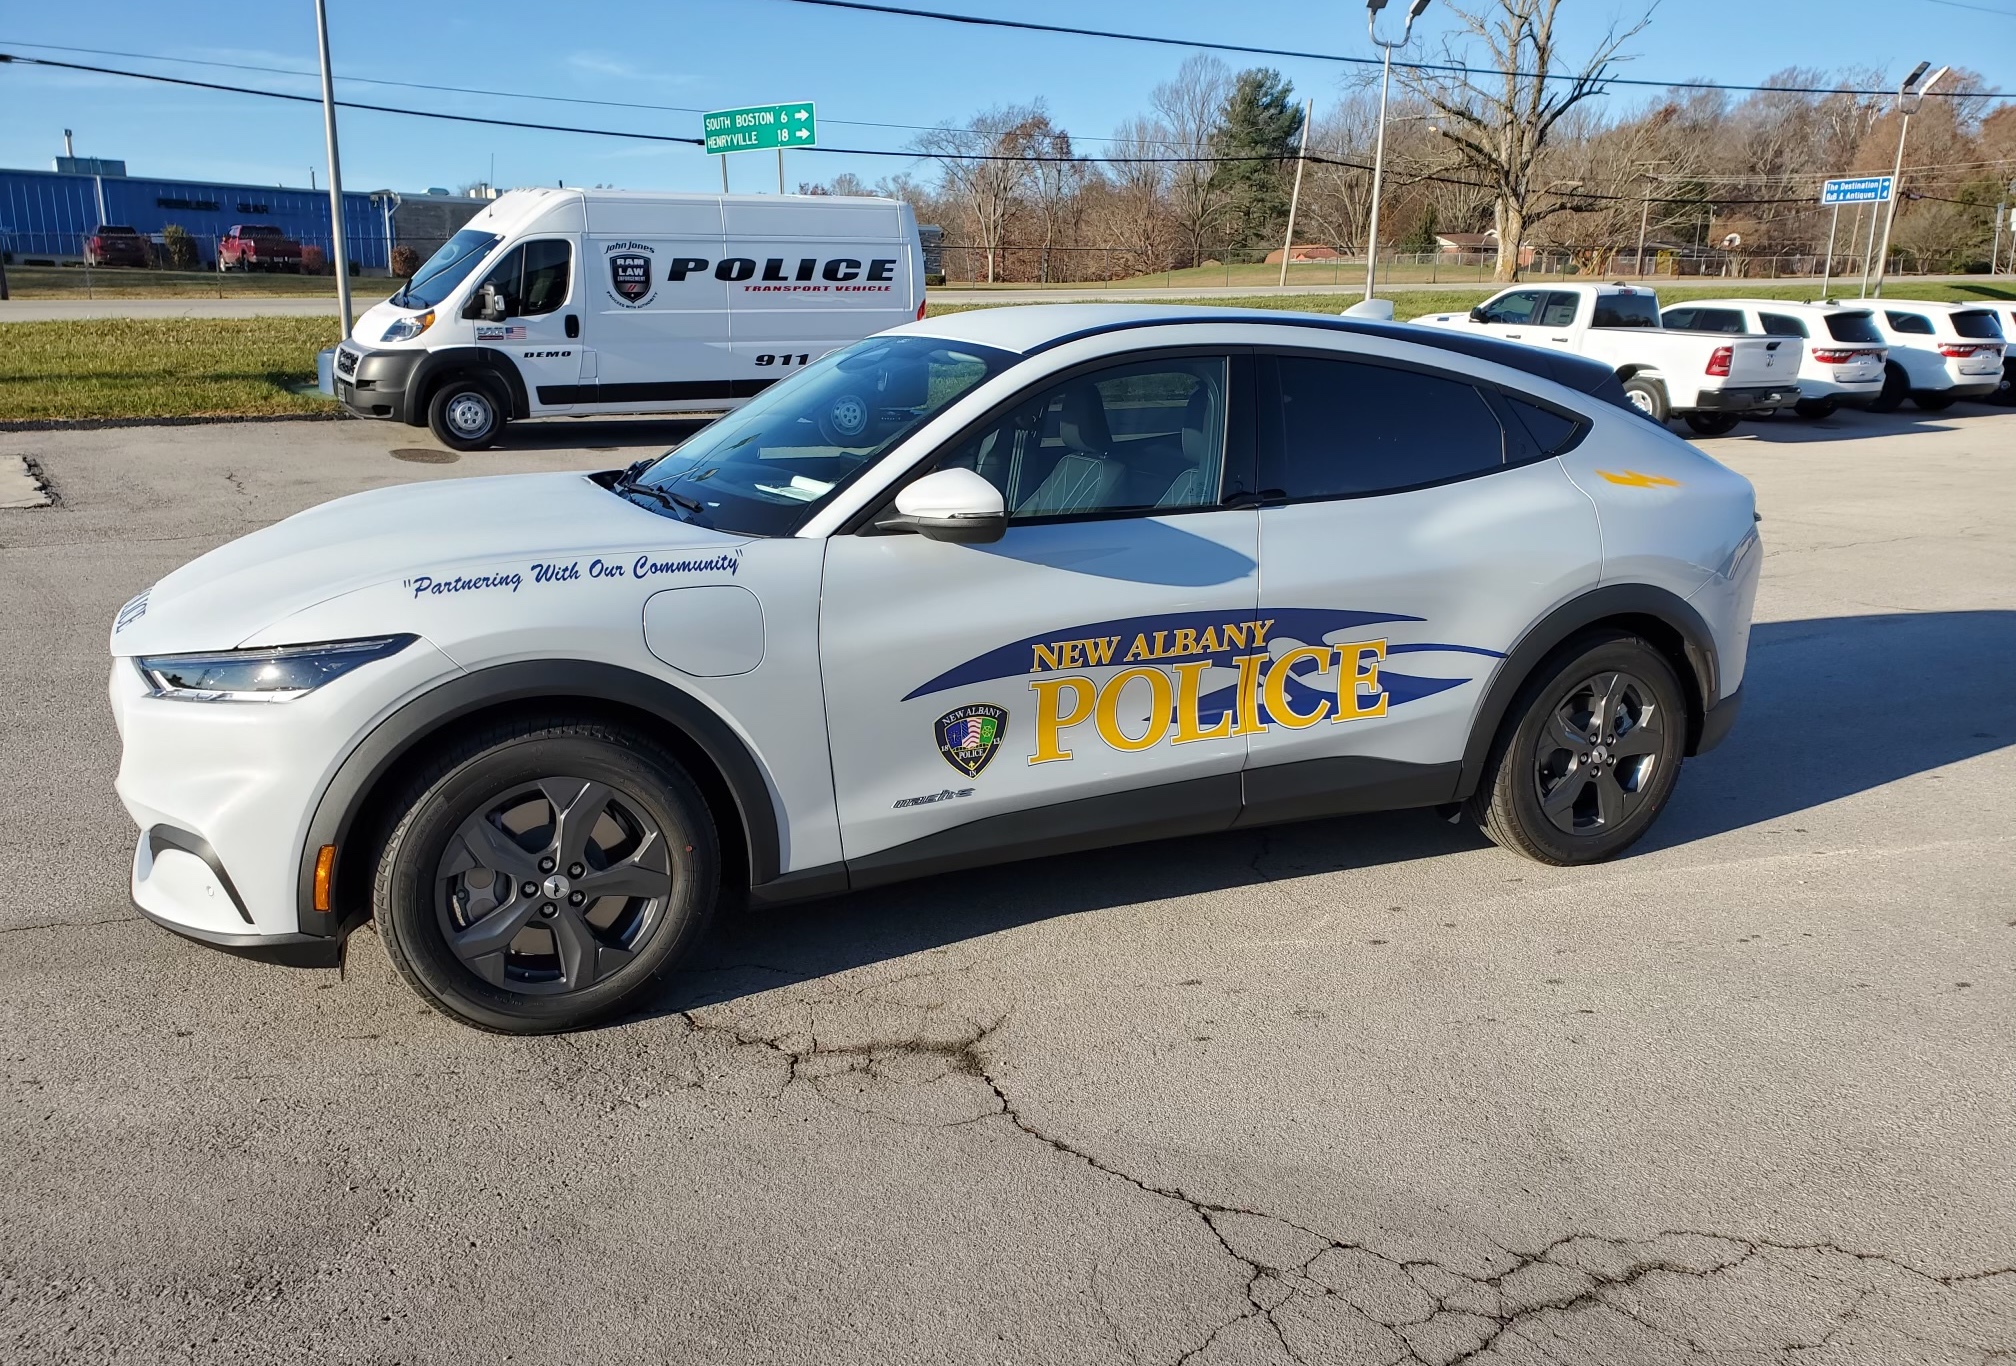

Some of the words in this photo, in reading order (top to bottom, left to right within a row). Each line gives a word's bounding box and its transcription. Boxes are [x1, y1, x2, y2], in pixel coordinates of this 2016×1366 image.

[706, 116, 731, 131] SOUTH
[735, 111, 774, 128] BOSTON
[780, 111, 788, 123] 6
[707, 131, 758, 149] HENRYVILLE
[777, 128, 789, 142] 18
[1827, 183, 1839, 191] The
[1840, 182, 1878, 190] Destination
[1846, 192, 1875, 200] Antiques
[667, 258, 897, 282] POLICE
[523, 350, 572, 358] DEMO
[755, 353, 809, 366] 911
[530, 561, 581, 584] With
[588, 558, 626, 579] Our
[1030, 637, 1121, 672] NEW
[1122, 619, 1275, 664] ALBANY
[1027, 638, 1389, 767] POLICE
[942, 710, 965, 726] NEW
[965, 706, 1002, 718] ALBANY
[958, 748, 984, 760] POLICE
[968, 769, 977, 777] IN
